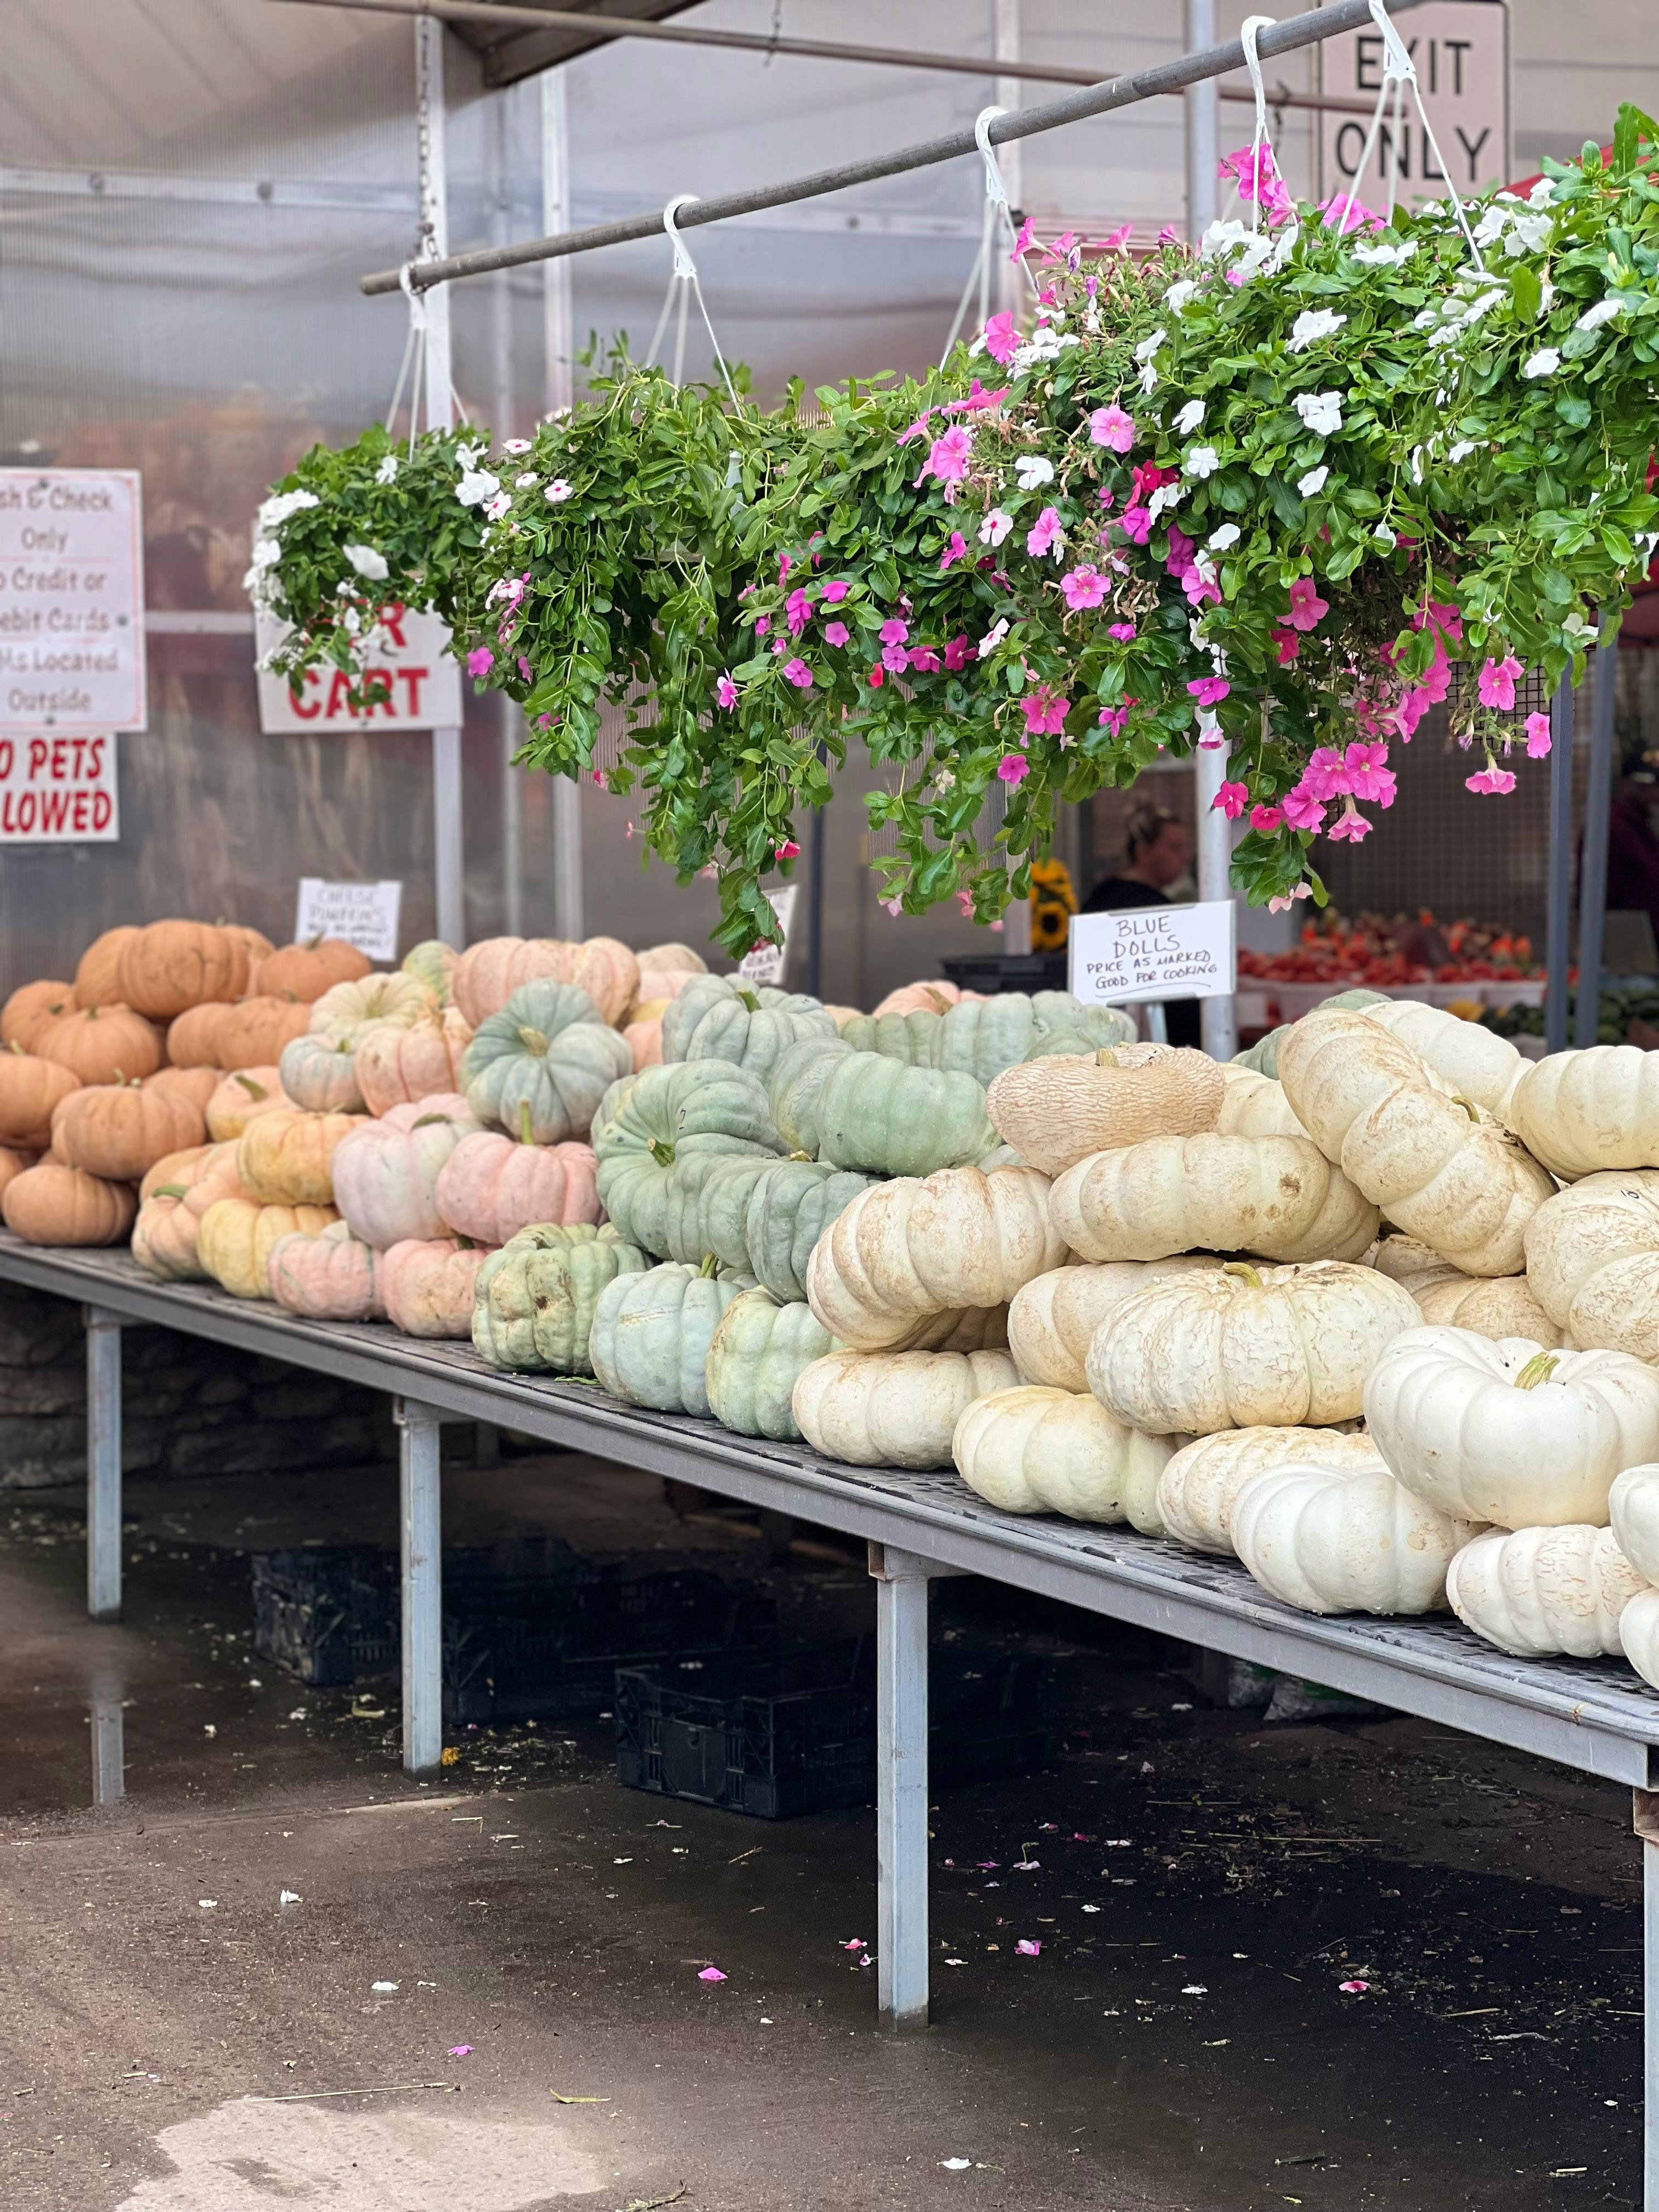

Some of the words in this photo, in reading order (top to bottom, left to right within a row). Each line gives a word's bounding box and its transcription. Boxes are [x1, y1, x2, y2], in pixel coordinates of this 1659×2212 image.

[1357, 36, 1471, 94] EIT
[1336, 122, 1491, 182] ONLY
[49, 487, 114, 512] Check
[21, 526, 69, 554] Only
[12, 566, 76, 591] Credit
[84, 573, 106, 591] or
[48, 607, 110, 631] Cards
[33, 647, 119, 672] Located
[8, 687, 92, 712] Outside
[289, 668, 428, 719] CART
[29, 737, 105, 780] PETS
[1116, 916, 1171, 937] BLUE
[1113, 934, 1180, 958] DOLLS
[1087, 961, 1124, 974] PRICE
[1133, 957, 1150, 968] AS
[1157, 950, 1210, 966] MARKED
[1096, 976, 1128, 989] GOOD
[1136, 972, 1158, 983] FOR
[1163, 964, 1217, 979] COOKING
